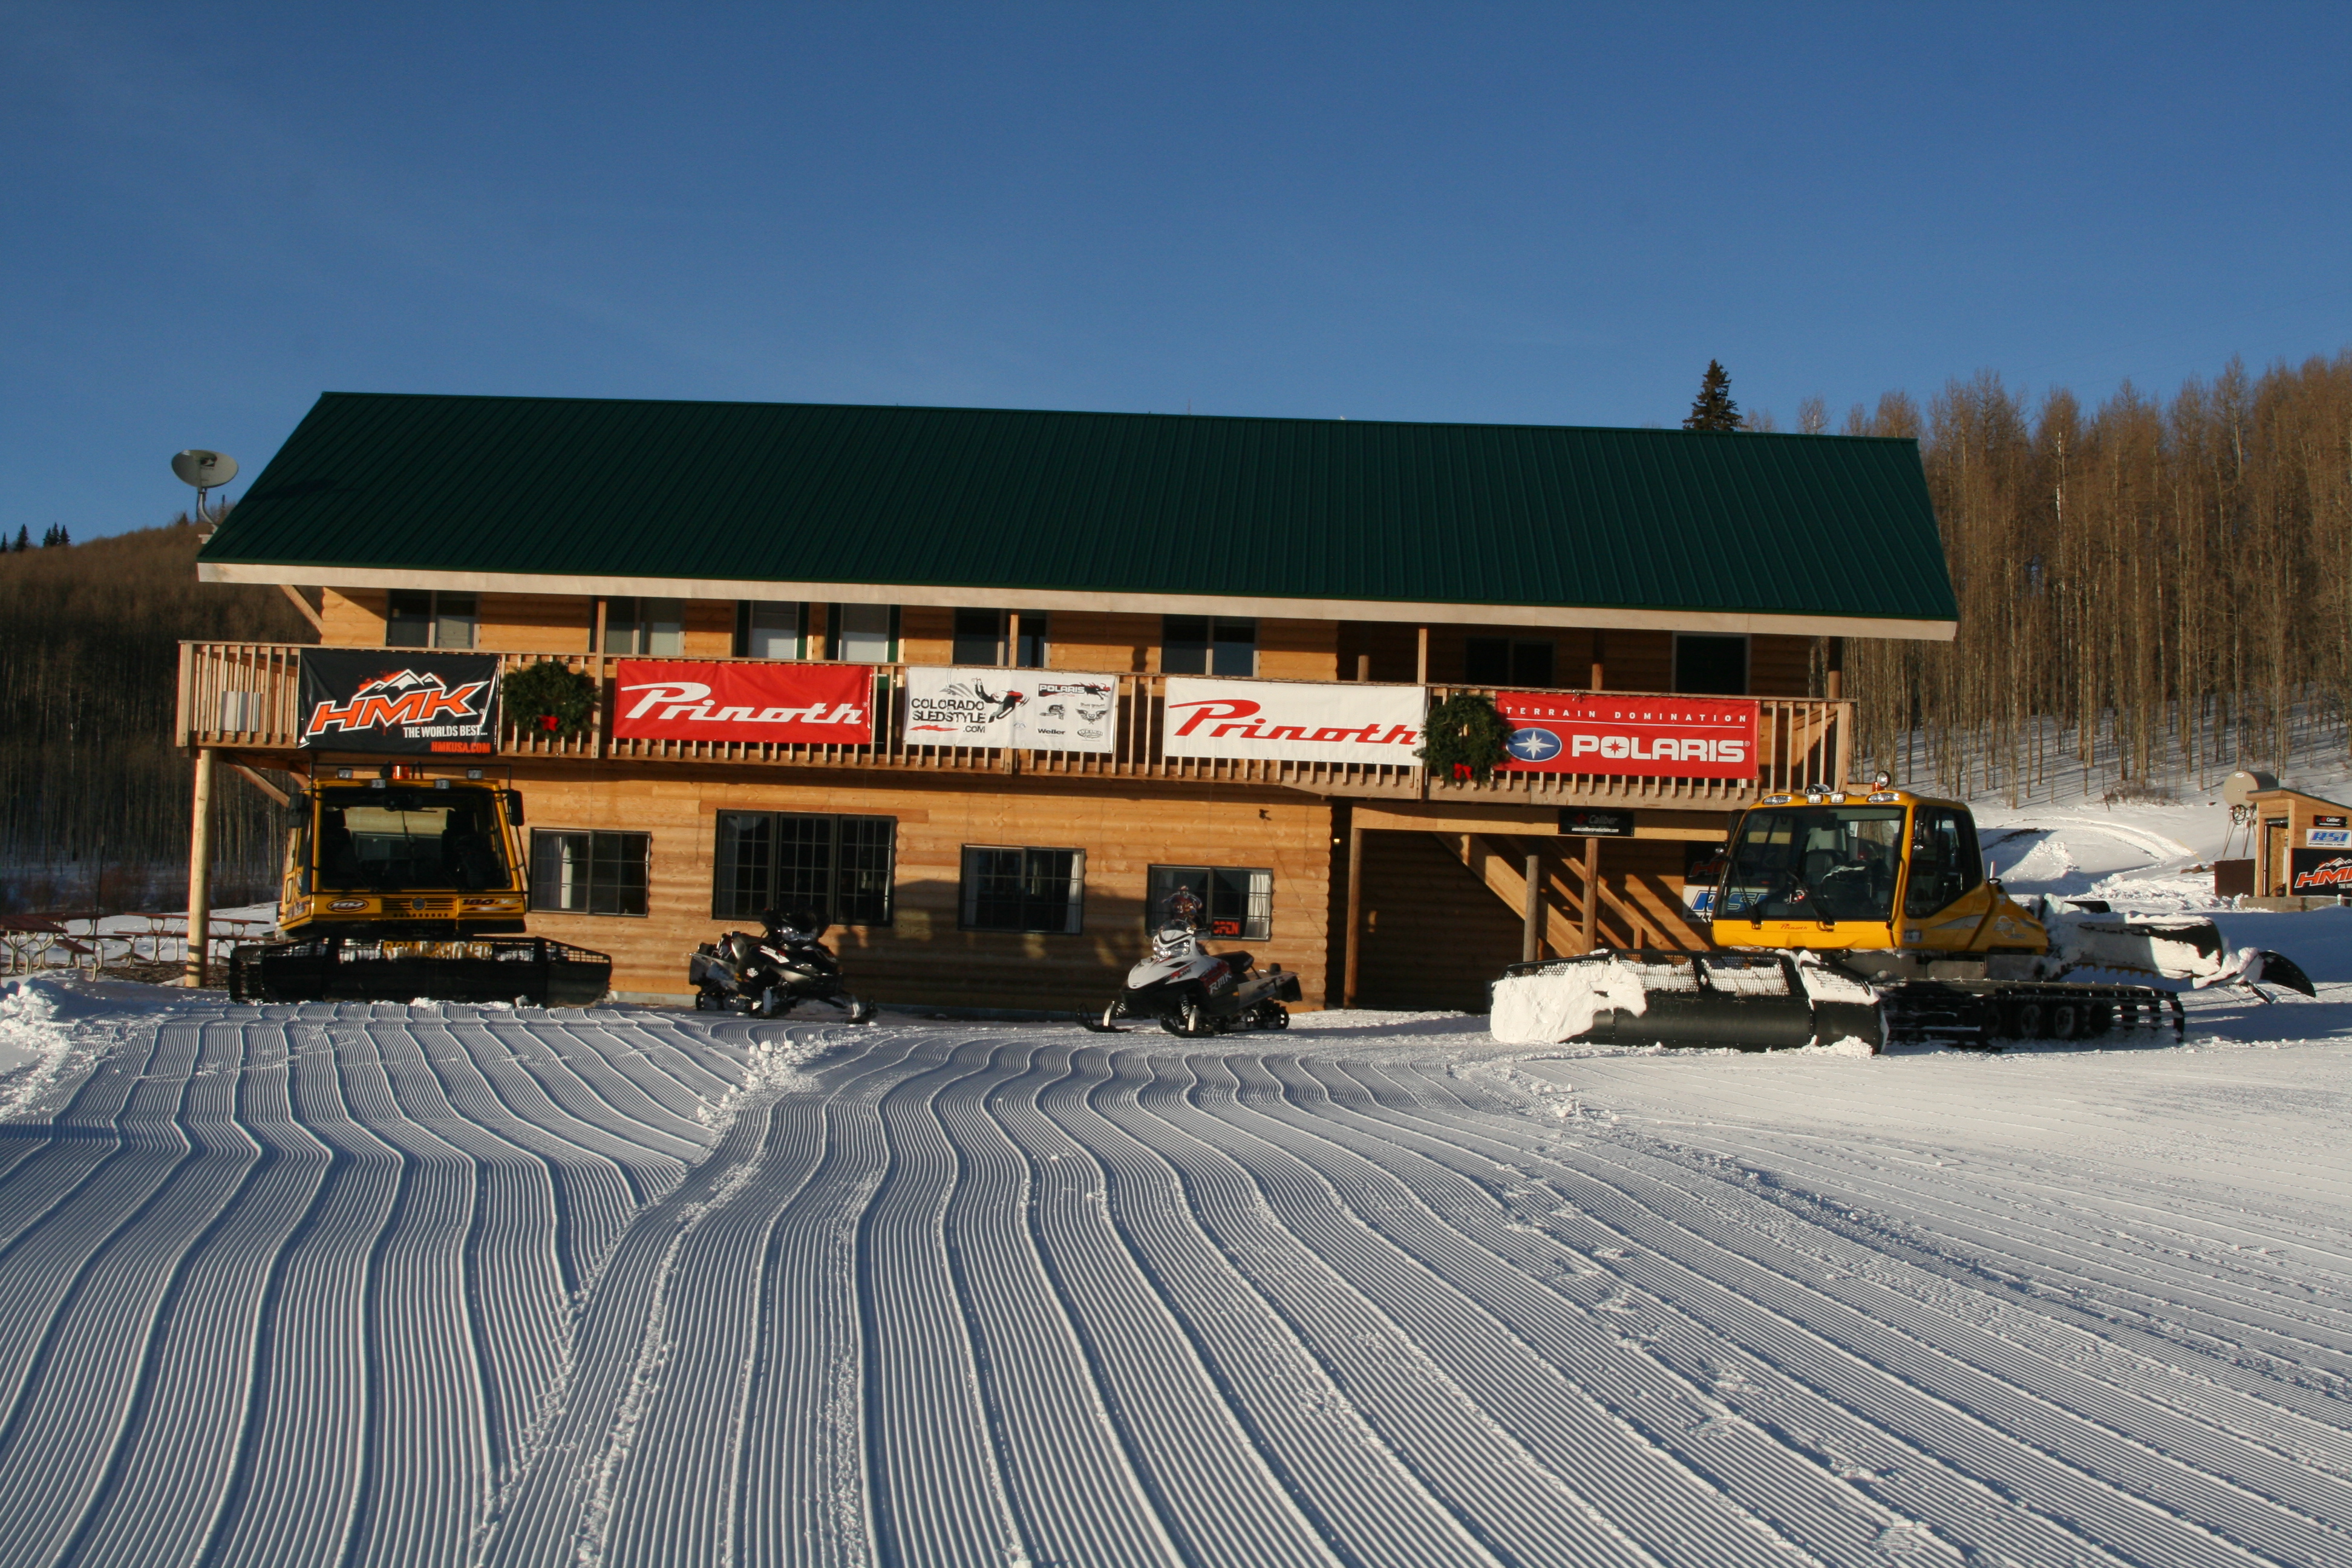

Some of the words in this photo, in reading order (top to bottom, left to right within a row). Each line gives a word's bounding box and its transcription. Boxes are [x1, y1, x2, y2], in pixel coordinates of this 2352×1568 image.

[1039, 684, 1085, 694] POLARIS
[306, 681, 490, 736] HMK
[621, 681, 863, 725] Prinoth
[911, 698, 985, 711] COLORADO
[913, 711, 985, 724] SLEDSTYLE
[1506, 706, 1596, 718] TERRAIN
[1615, 711, 1746, 723] DOMINATION
[1169, 699, 1419, 745] Prinoth
[403, 727, 420, 738] THE
[421, 726, 459, 737] WORLDS
[431, 742, 491, 753] HMKUSA.COM
[1572, 734, 1745, 763] POLARIS
[1589, 814, 1618, 825] Caliber
[2310, 831, 2350, 843] RSI
[1213, 920, 1240, 935] OPEN
[1209, 971, 1232, 994] RMK
